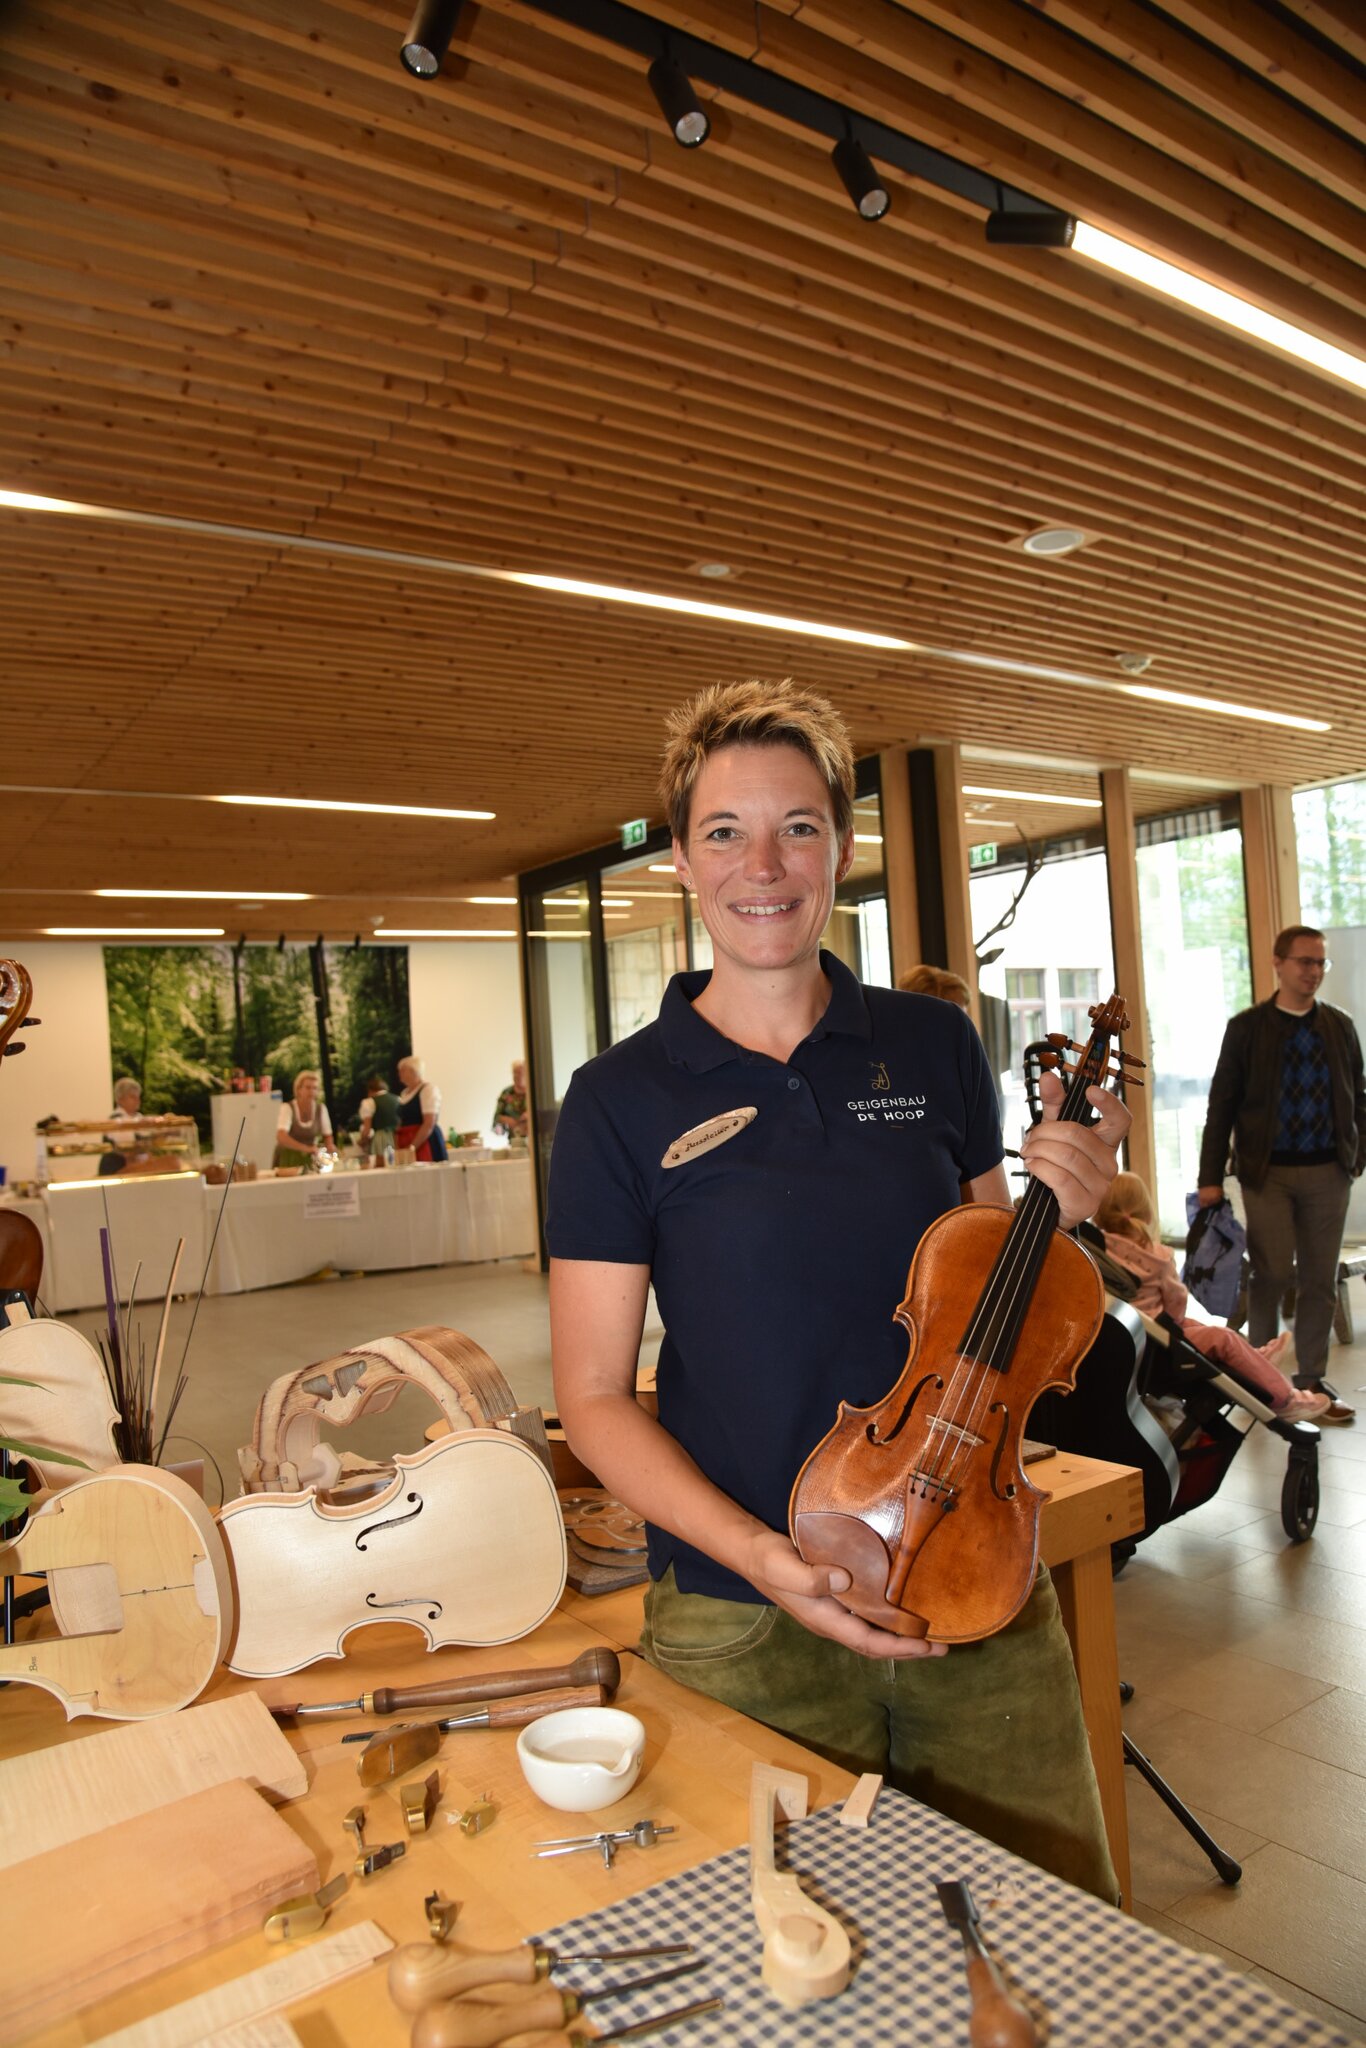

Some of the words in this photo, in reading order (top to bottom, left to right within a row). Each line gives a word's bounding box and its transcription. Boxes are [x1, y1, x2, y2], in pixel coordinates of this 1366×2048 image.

[847, 1095, 926, 1111] GEIGENBAU
[857, 1113, 877, 1122] DE
[883, 1109, 925, 1121] HOOP
